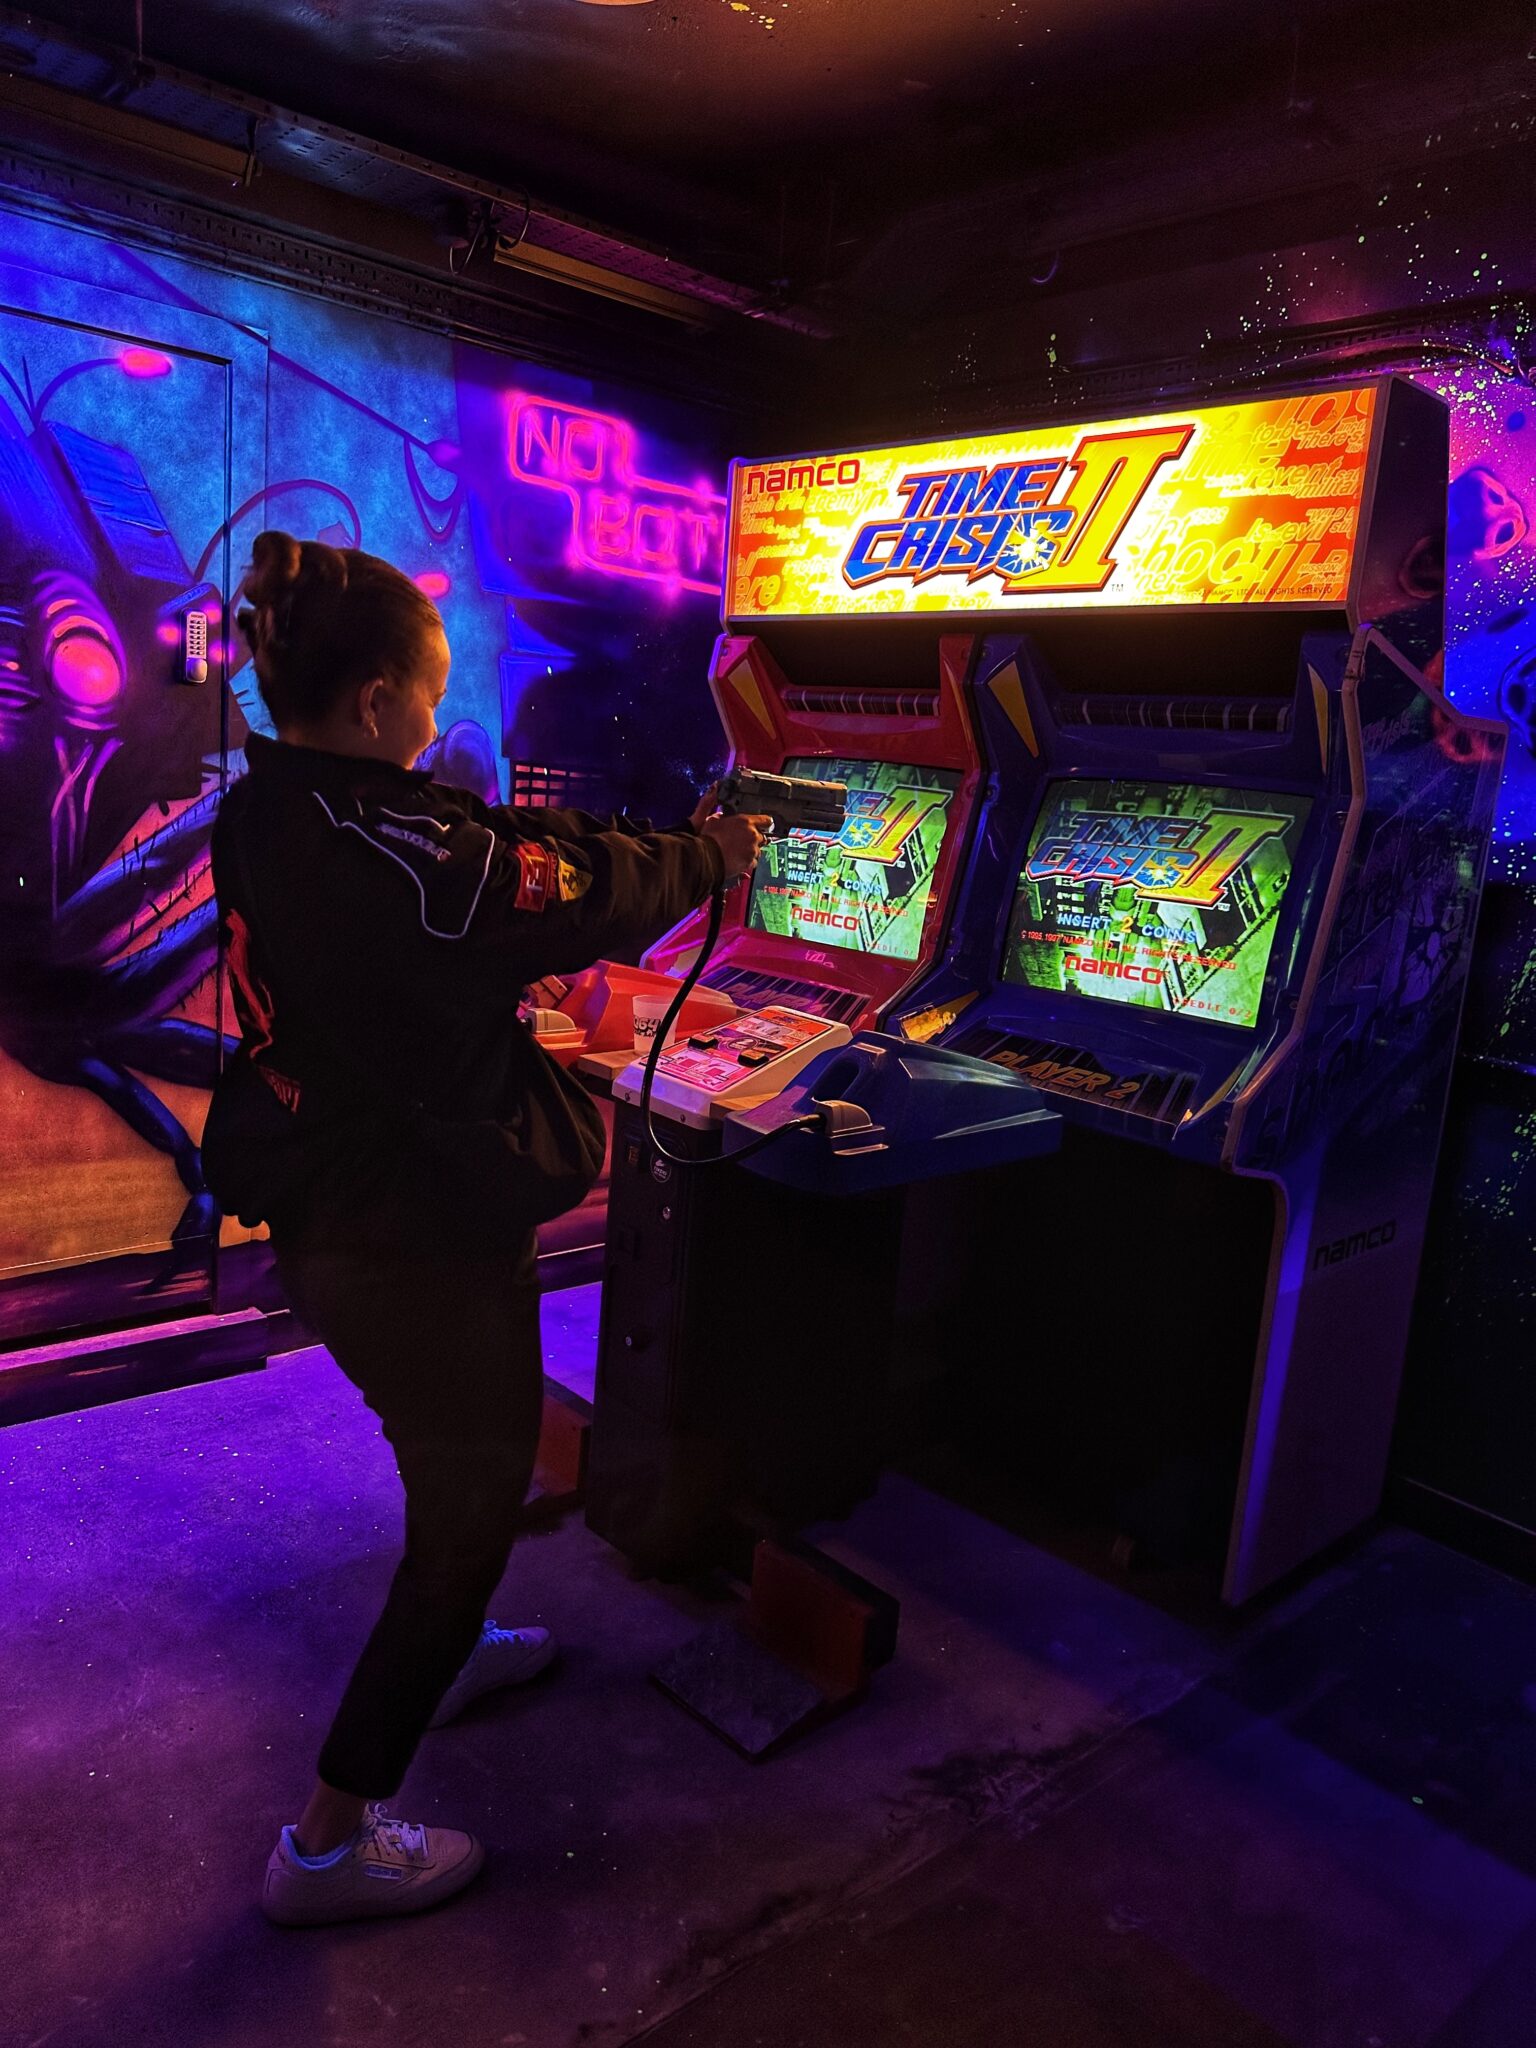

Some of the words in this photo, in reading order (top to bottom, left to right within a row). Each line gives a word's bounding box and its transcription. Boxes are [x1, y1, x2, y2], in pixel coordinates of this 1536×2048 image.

[523, 410, 607, 482] NO
[746, 459, 861, 495] namco
[897, 456, 1068, 520] TIME
[842, 503, 1077, 591] CRISIS
[1068, 810, 1199, 849] TIME
[829, 873, 840, 888] 2
[843, 878, 882, 894] COINS
[1026, 837, 1200, 890] CRISIS
[791, 906, 859, 932] namco
[1056, 912, 1112, 930] INSERT
[1121, 915, 1134, 934] 2
[1141, 923, 1197, 944] COINS
[1064, 954, 1164, 985] namco
[986, 1048, 1112, 1094] PLAYER
[1104, 1080, 1142, 1101] 2
[1312, 1219, 1397, 1271] namco
